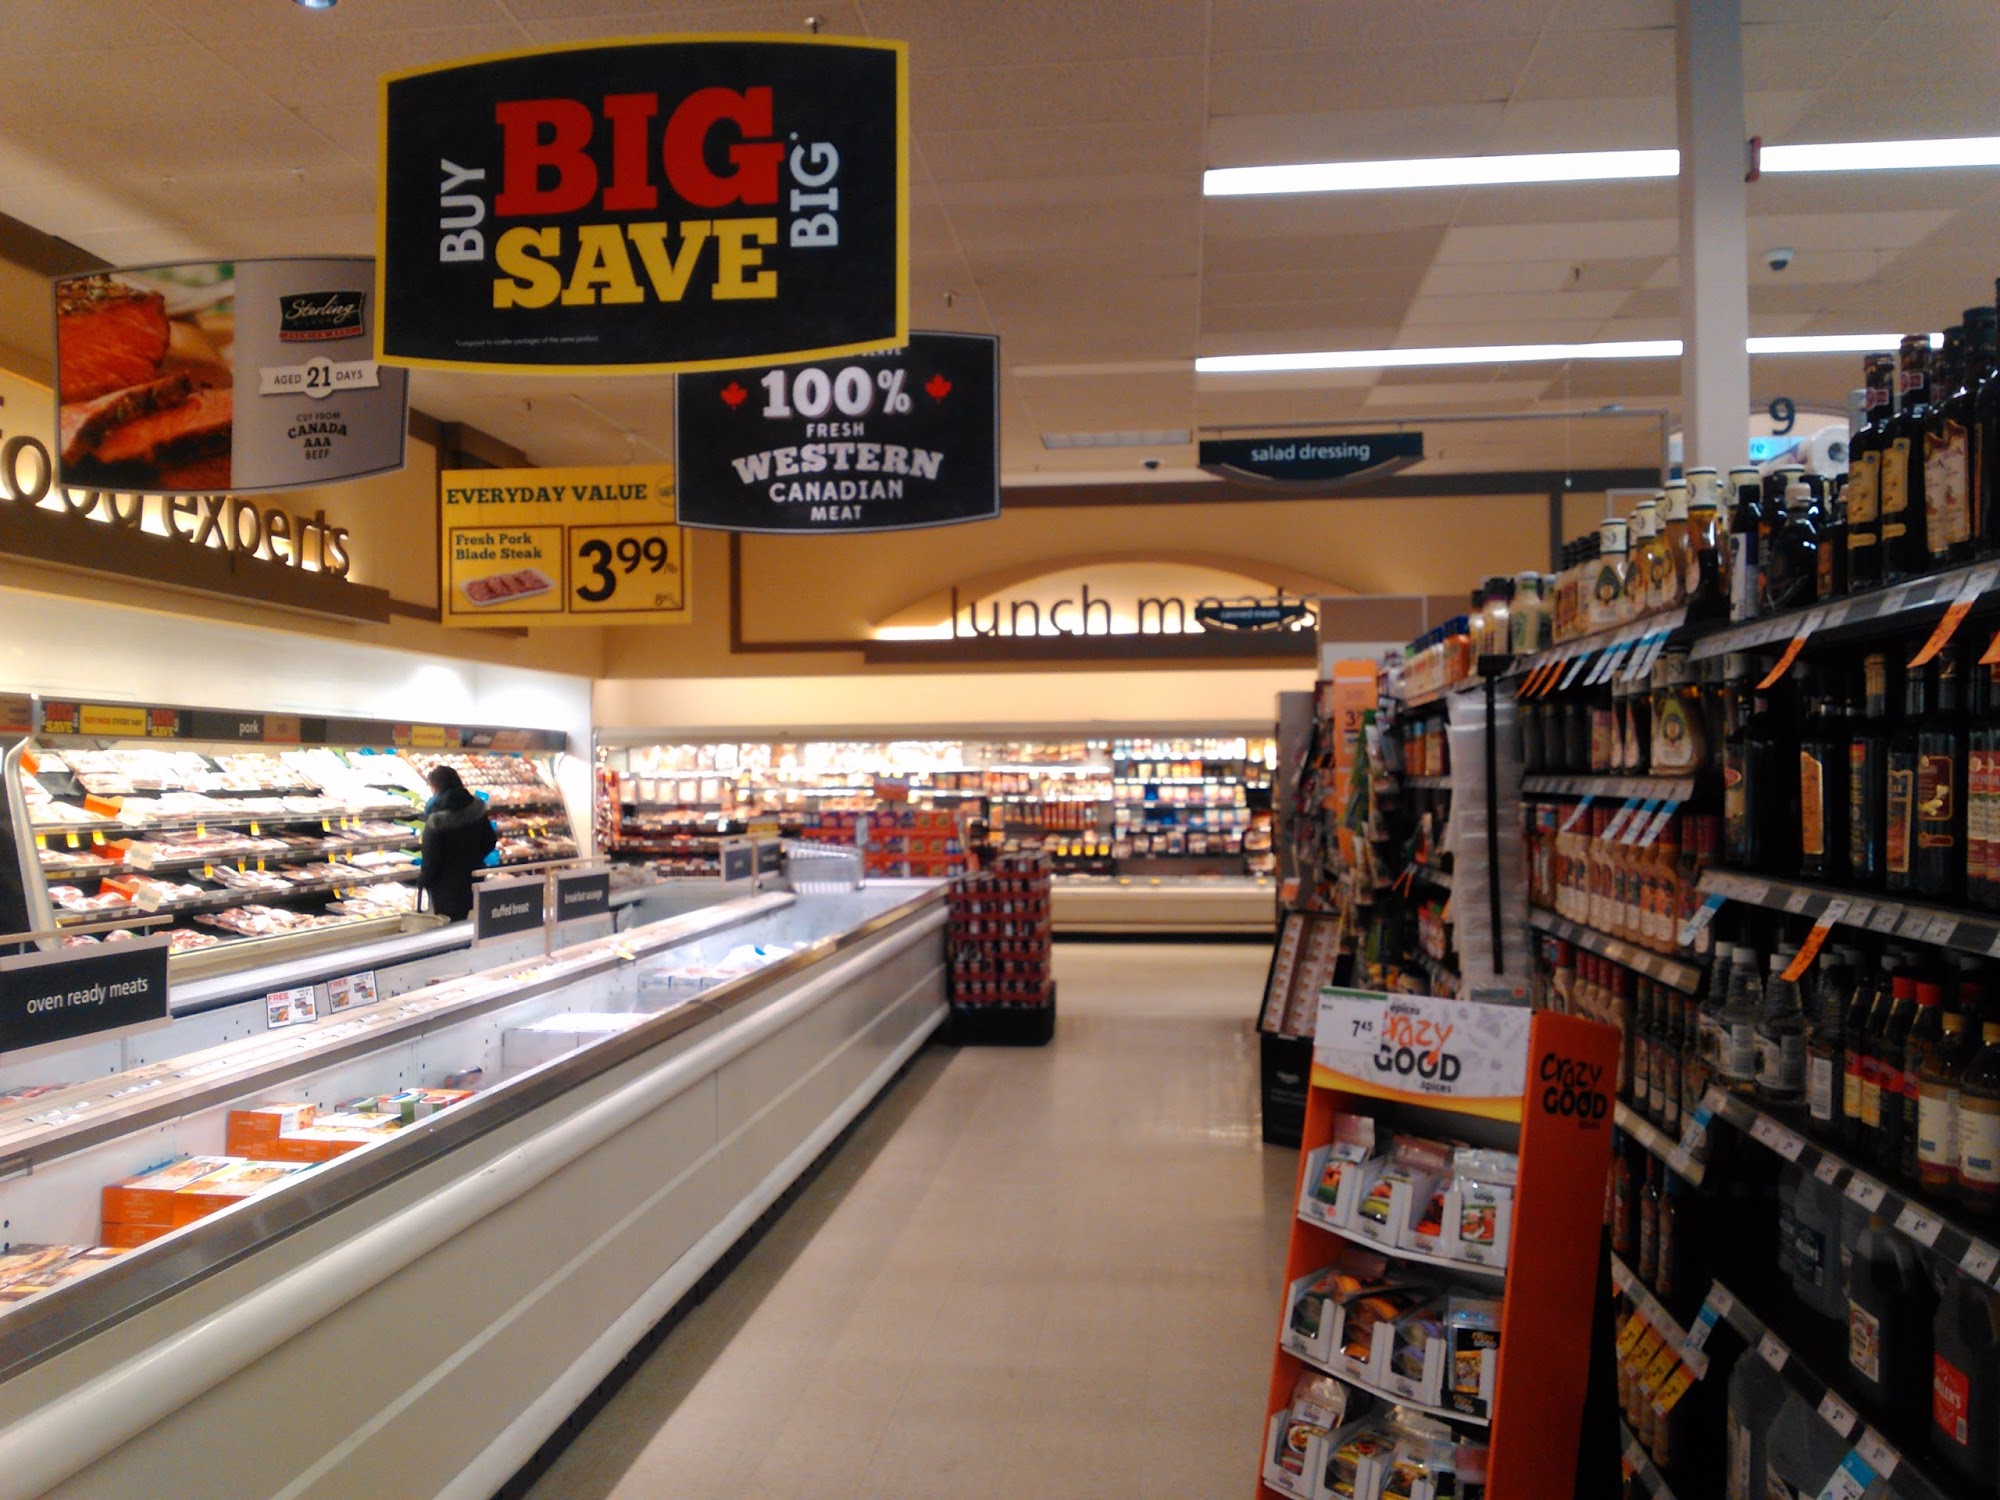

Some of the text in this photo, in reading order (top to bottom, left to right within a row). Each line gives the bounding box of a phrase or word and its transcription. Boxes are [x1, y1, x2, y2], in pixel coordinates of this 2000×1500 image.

[494, 86, 785, 217] BIG
[439, 159, 485, 262] BUY
[492, 217, 778, 308] SAVE
[274, 366, 363, 388] AGED 21 DAYS
[761, 366, 911, 418] 100%
[1769, 397, 1795, 436] 9
[288, 422, 347, 439] CANADA
[806, 422, 864, 438] FRESH
[304, 437, 331, 448] AAA
[1251, 443, 1370, 462] salad dressing
[305, 449, 330, 460] BEEF
[732, 443, 943, 485] WESTERN
[446, 486, 565, 504] EVERYDAY
[571, 484, 647, 501] VALUE
[769, 480, 903, 502] CANADIAN
[810, 505, 862, 521] MEAT
[162, 495, 350, 579] experts
[456, 533, 532, 545] Fresh Pork
[456, 547, 542, 560] Blade Steak
[951, 584, 1112, 637] lunch
[239, 720, 259, 735] pork
[329, 978, 348, 989] FREE
[27, 977, 149, 1014] oven ready meats
[268, 992, 289, 1002] FREE
[1382, 1009, 1454, 1057] razy
[1374, 1044, 1461, 1082] GOOD
[1543, 1086, 1608, 1119] GOOD
